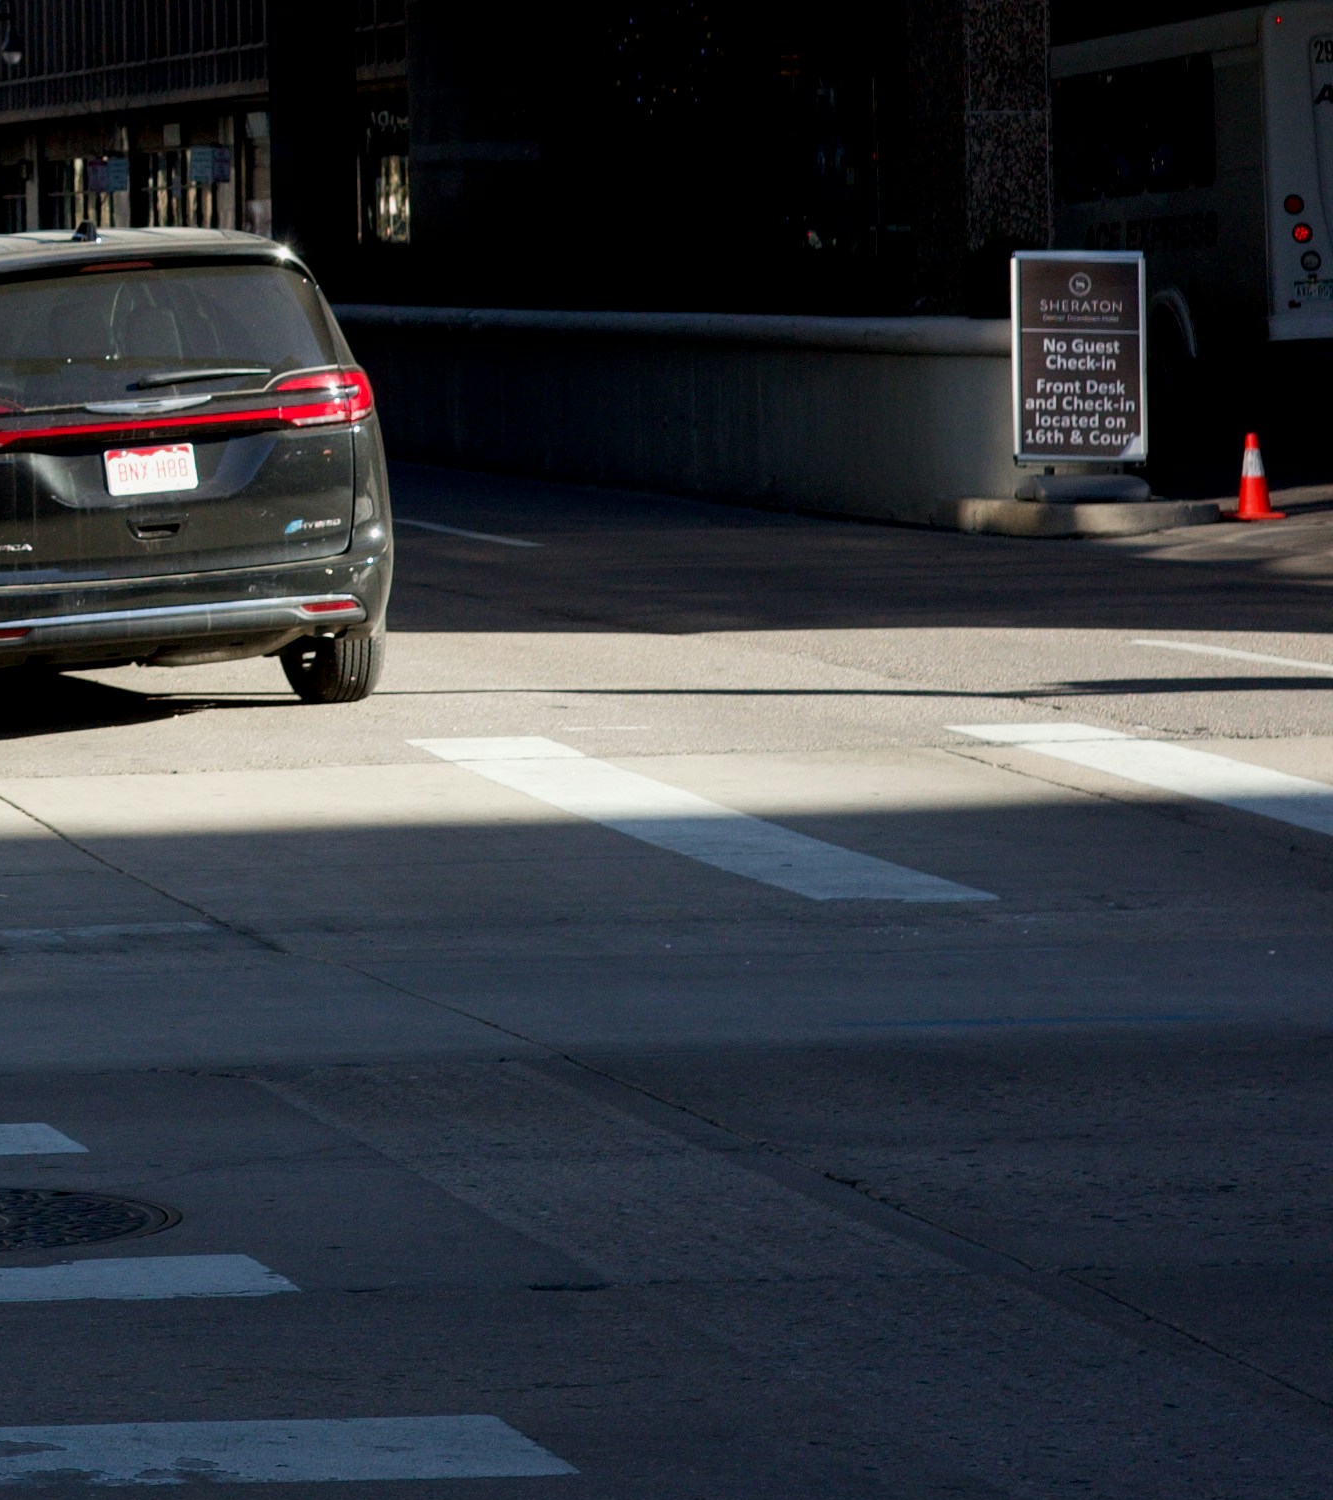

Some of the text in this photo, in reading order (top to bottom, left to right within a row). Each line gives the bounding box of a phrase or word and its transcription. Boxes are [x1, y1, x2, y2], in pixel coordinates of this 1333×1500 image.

[1039, 299, 1124, 314] SHERATON
[1043, 338, 1121, 355] No Guest
[1046, 355, 1117, 371] Check-in
[1036, 378, 1126, 396] Front Desk
[1025, 395, 1136, 412] and Check-in
[1035, 413, 1127, 429] located on
[1025, 429, 1064, 445] 16th
[1070, 429, 1083, 445] &
